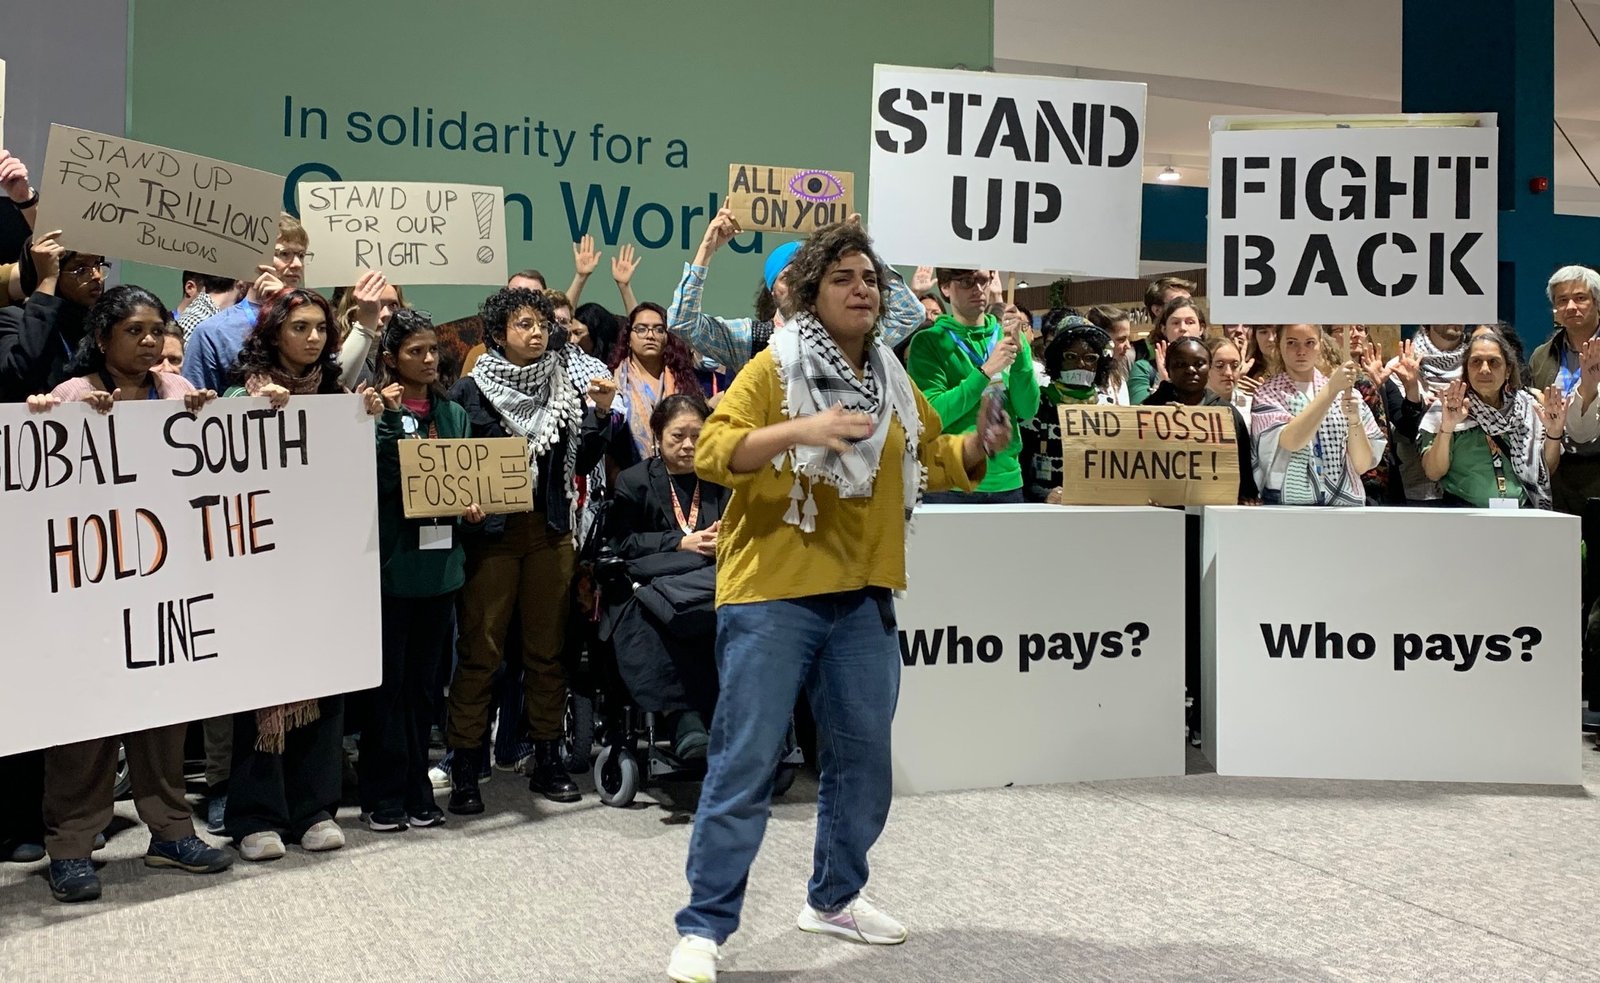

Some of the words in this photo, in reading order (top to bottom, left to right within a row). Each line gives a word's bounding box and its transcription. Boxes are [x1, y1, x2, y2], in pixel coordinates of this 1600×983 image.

[284, 95, 326, 139] In
[346, 106, 576, 167] solidarity
[590, 123, 651, 164] for
[666, 140, 688, 168] a
[876, 88, 1138, 167] STAND
[70, 136, 180, 177] STAND
[193, 162, 232, 191] UP
[732, 165, 781, 195] ALL
[1222, 156, 1488, 221] FIGHT
[60, 160, 120, 198] FOR
[139, 178, 272, 245] TRILLIONS
[82, 201, 139, 224] NOT
[309, 186, 407, 211] STAND
[426, 190, 457, 213] UP
[324, 214, 381, 234] FOR
[396, 215, 447, 235] OUR
[751, 196, 788, 228] ON
[792, 199, 847, 229] YOU
[952, 176, 1062, 243] UP
[137, 221, 217, 263] BILLIONS
[355, 239, 449, 269] RIGHTS
[1224, 232, 1485, 297] BACK
[0, 414, 137, 492] LOBAL
[163, 408, 308, 477] SOUTH
[1065, 409, 1121, 437] END
[1136, 410, 1236, 444] FOSSIL
[417, 443, 489, 472] STOP
[500, 446, 528, 505] FUEL
[408, 474, 503, 509] FOSSIL
[48, 508, 168, 593] HOLD
[189, 490, 275, 561] THE
[124, 593, 218, 669] LINE
[898, 625, 1003, 666] Who
[1019, 621, 1150, 672] pays?
[1260, 622, 1376, 660] Who
[1394, 627, 1542, 671] pays?
